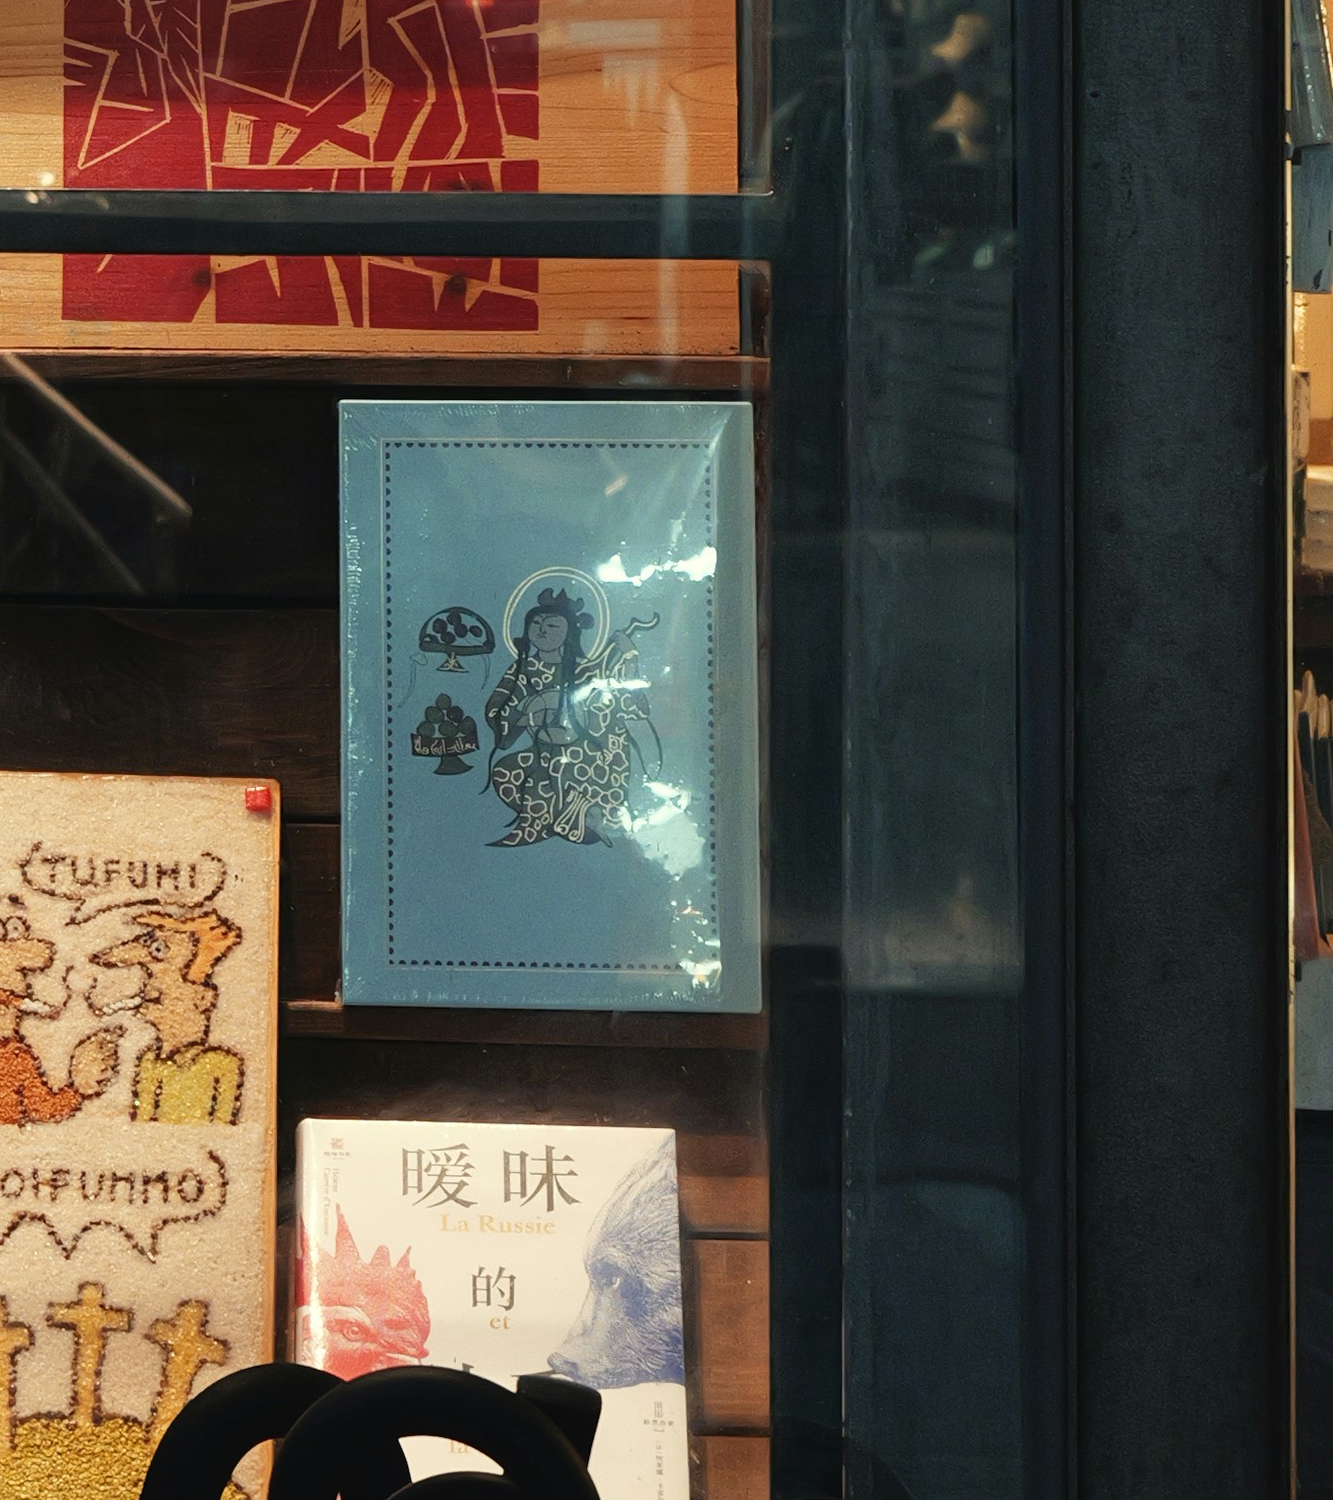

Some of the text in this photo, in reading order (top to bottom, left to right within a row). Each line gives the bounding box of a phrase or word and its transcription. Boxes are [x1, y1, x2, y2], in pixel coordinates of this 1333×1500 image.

[400, 1142, 582, 1213] 暧昧
[439, 1214, 557, 1236] La Russie
[470, 1265, 518, 1313] 的
[489, 1312, 512, 1331] et
